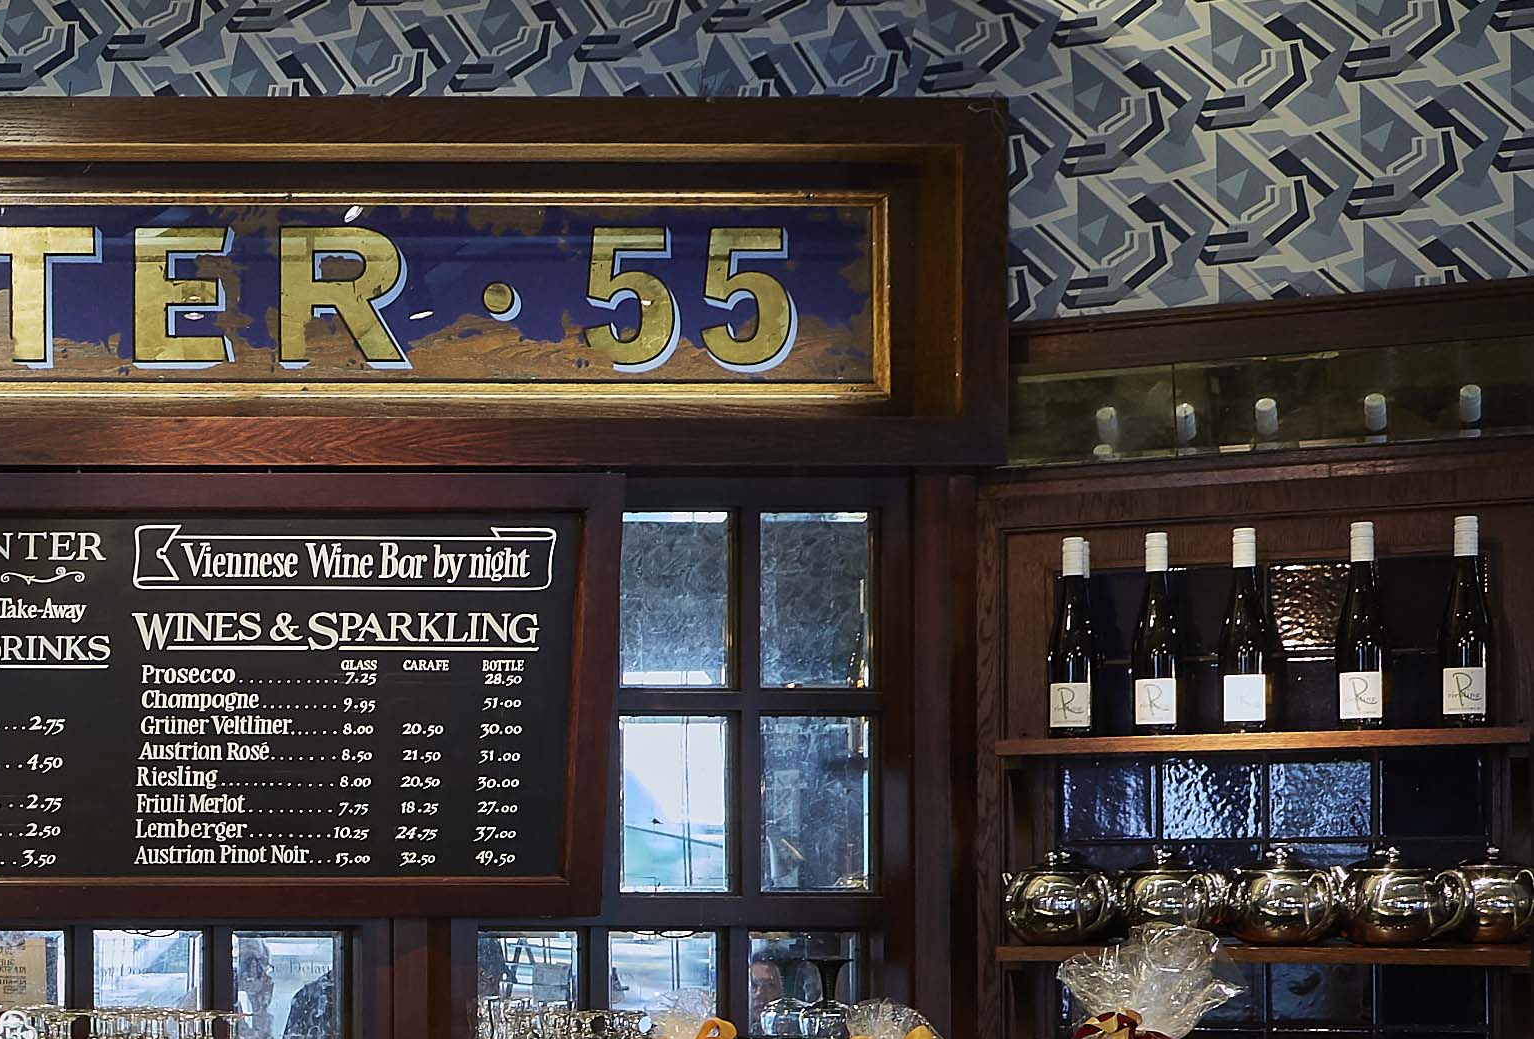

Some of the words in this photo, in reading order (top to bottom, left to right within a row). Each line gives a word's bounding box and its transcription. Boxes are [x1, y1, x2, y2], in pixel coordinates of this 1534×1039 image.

[584, 225, 798, 373] 55
[180, 542, 299, 578] Viennese
[304, 542, 374, 579] Wine
[377, 542, 428, 579] Bar
[433, 543, 468, 584] by
[467, 546, 531, 582] night
[131, 612, 262, 651] WINES
[269, 612, 304, 642] &
[307, 611, 540, 652] SPARKLING
[141, 664, 236, 685] Prosecco
[344, 671, 378, 686] 7.25
[484, 672, 523, 687] 28.50
[340, 659, 378, 671] GLASS
[402, 659, 450, 672] CARAFE
[481, 659, 525, 672] BOTTLE
[141, 689, 260, 713] Champagne
[28, 715, 66, 736] 2.75
[140, 715, 210, 735] Grüner
[210, 714, 292, 737] Veltliner
[342, 722, 374, 736] 8.00
[401, 722, 444, 738] 20.50
[479, 723, 523, 739] 30.00
[26, 753, 64, 774] 4.50
[137, 741, 223, 761] Austrian
[225, 741, 270, 761] Rosé
[341, 748, 373, 764] 8.50
[402, 749, 442, 764] 21.50
[135, 765, 219, 790] Riesling
[25, 793, 63, 813] 2.75
[136, 793, 186, 814] Friuli
[187, 793, 246, 814] Merlot
[338, 801, 369, 817] 7.75
[401, 800, 439, 816] 18.25
[24, 822, 61, 839] 2.50
[134, 818, 248, 842] Lemberger
[333, 826, 370, 841] 10.25
[394, 825, 439, 841] 24.75
[20, 849, 57, 868] 3.50
[133, 844, 217, 865] Austrian
[219, 844, 268, 864] Pinot
[269, 844, 314, 864] Noir
